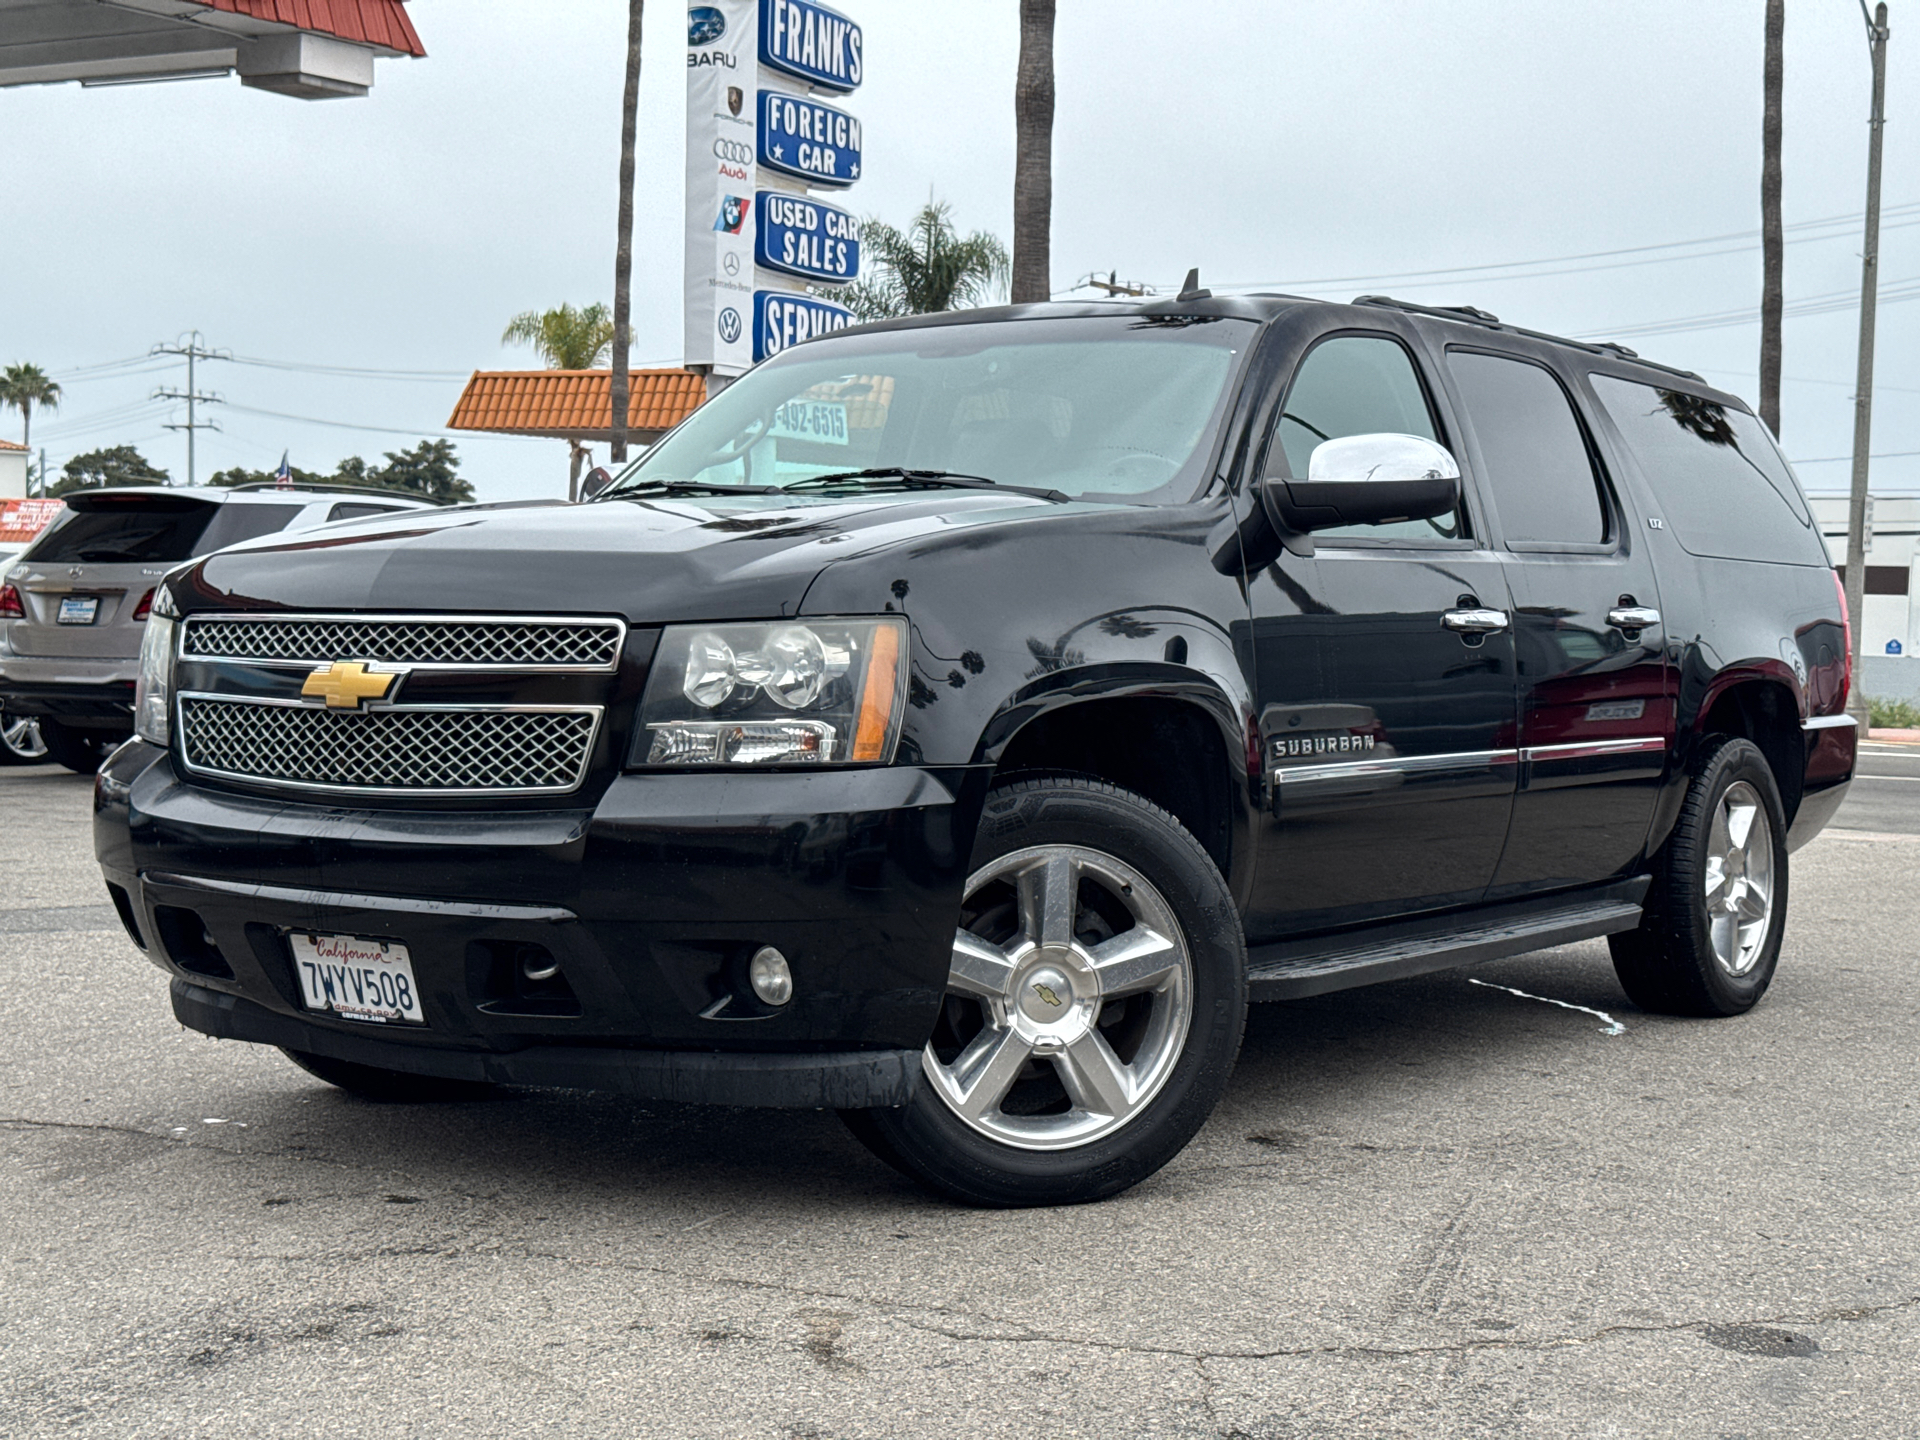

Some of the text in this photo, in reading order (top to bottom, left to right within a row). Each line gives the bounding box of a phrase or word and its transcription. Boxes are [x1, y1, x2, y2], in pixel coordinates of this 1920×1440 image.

[687, 51, 737, 70] BARU
[773, 0, 862, 84] FRANK'S
[770, 97, 861, 152] FOREIGN
[718, 163, 747, 181] Audi
[798, 143, 836, 175] CAR
[769, 198, 860, 242] USED CAR
[782, 231, 847, 275] SALES
[767, 300, 858, 355] SERVI
[770, 402, 844, 438] -492-6515
[1275, 735, 1375, 757] SUBURBAN
[316, 938, 392, 965] California
[302, 961, 413, 1011] 7WYV508
